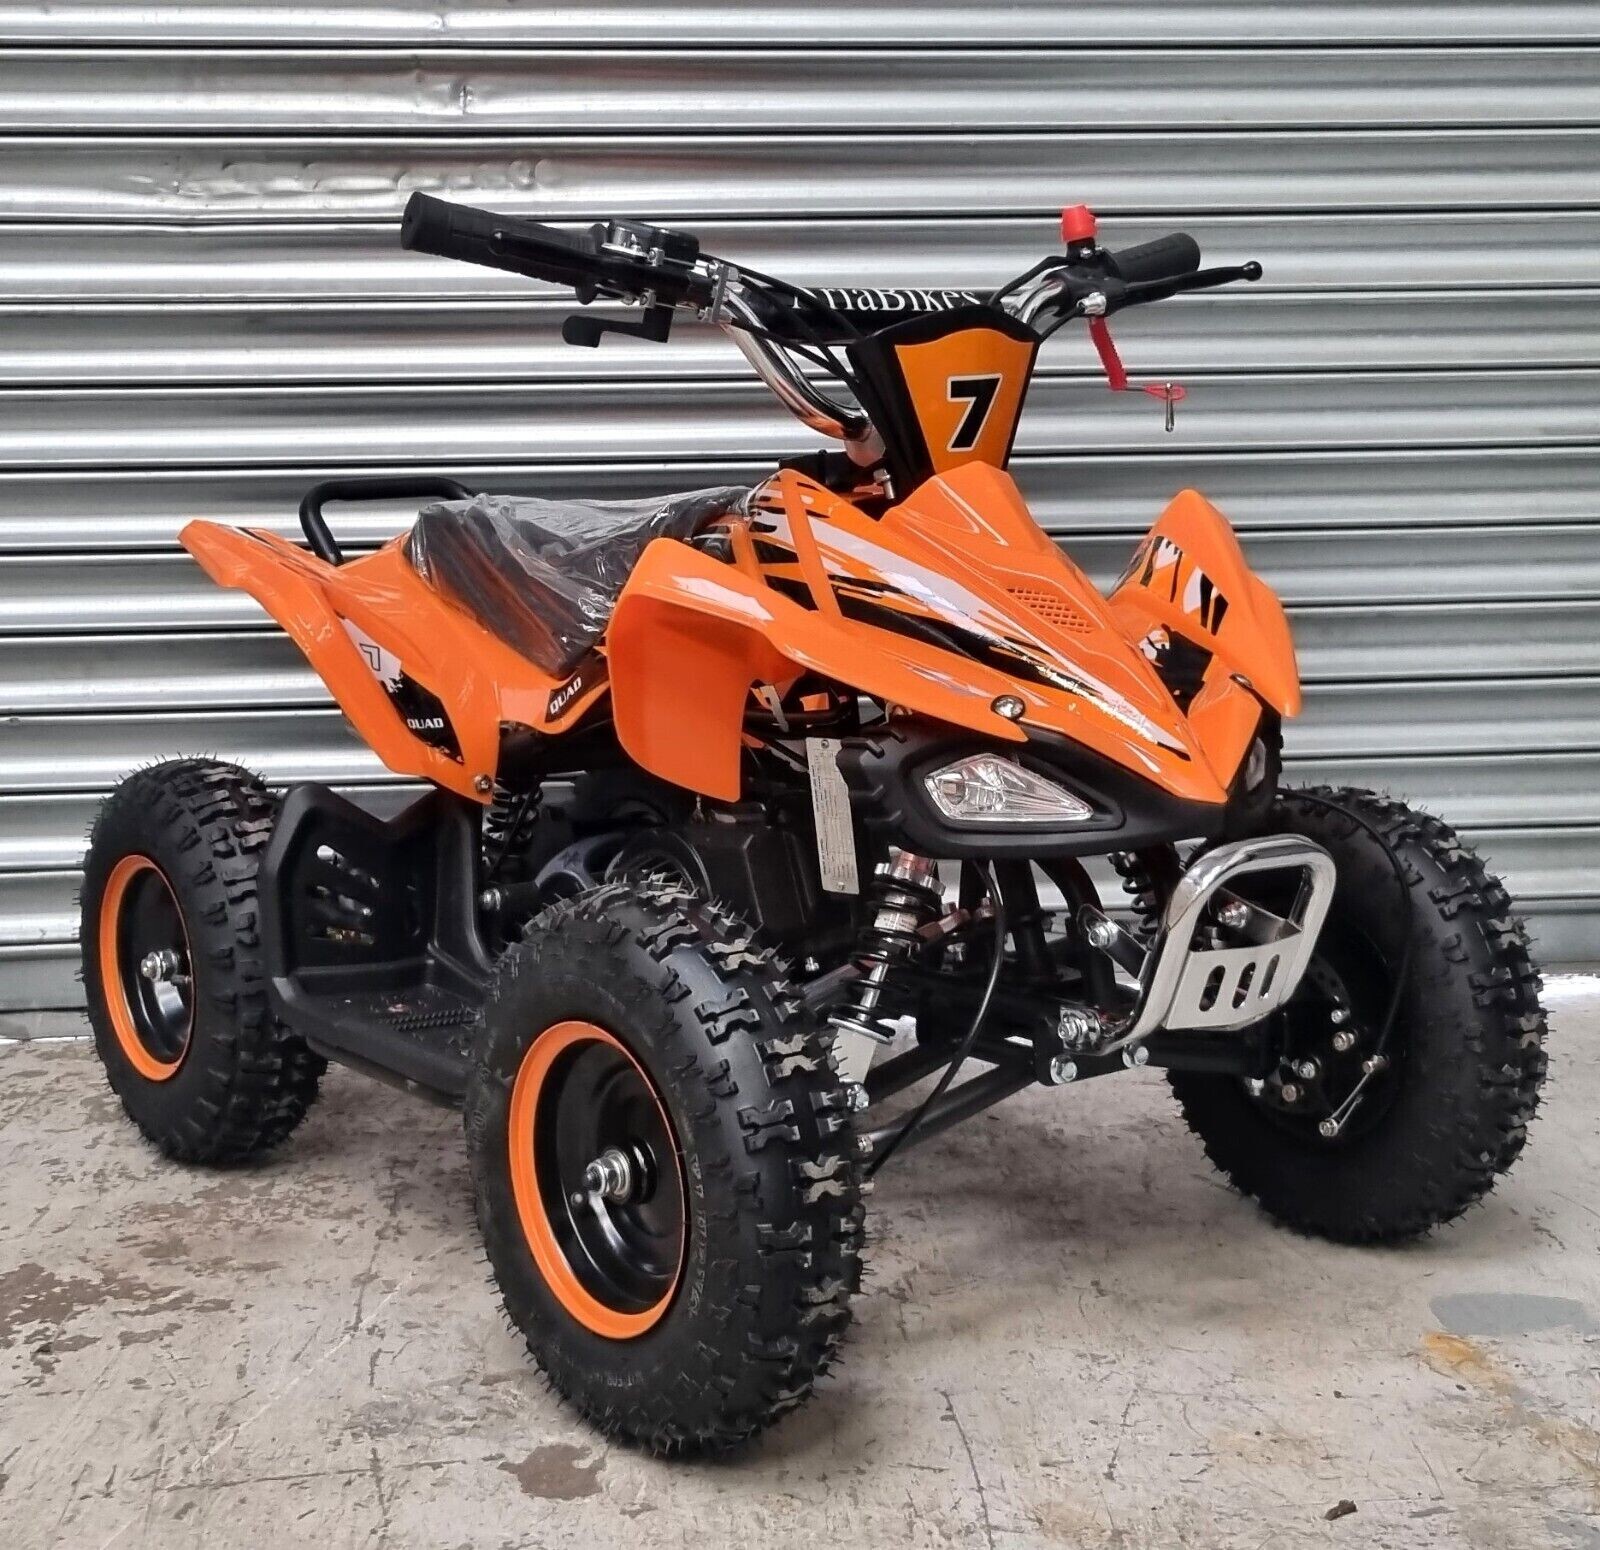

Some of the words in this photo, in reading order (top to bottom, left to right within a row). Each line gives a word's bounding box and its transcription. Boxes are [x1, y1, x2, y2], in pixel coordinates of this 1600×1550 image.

[946, 373, 1003, 453] 7
[359, 642, 381, 672] 7
[549, 676, 582, 715] QUAD
[406, 717, 444, 729] QUAD
